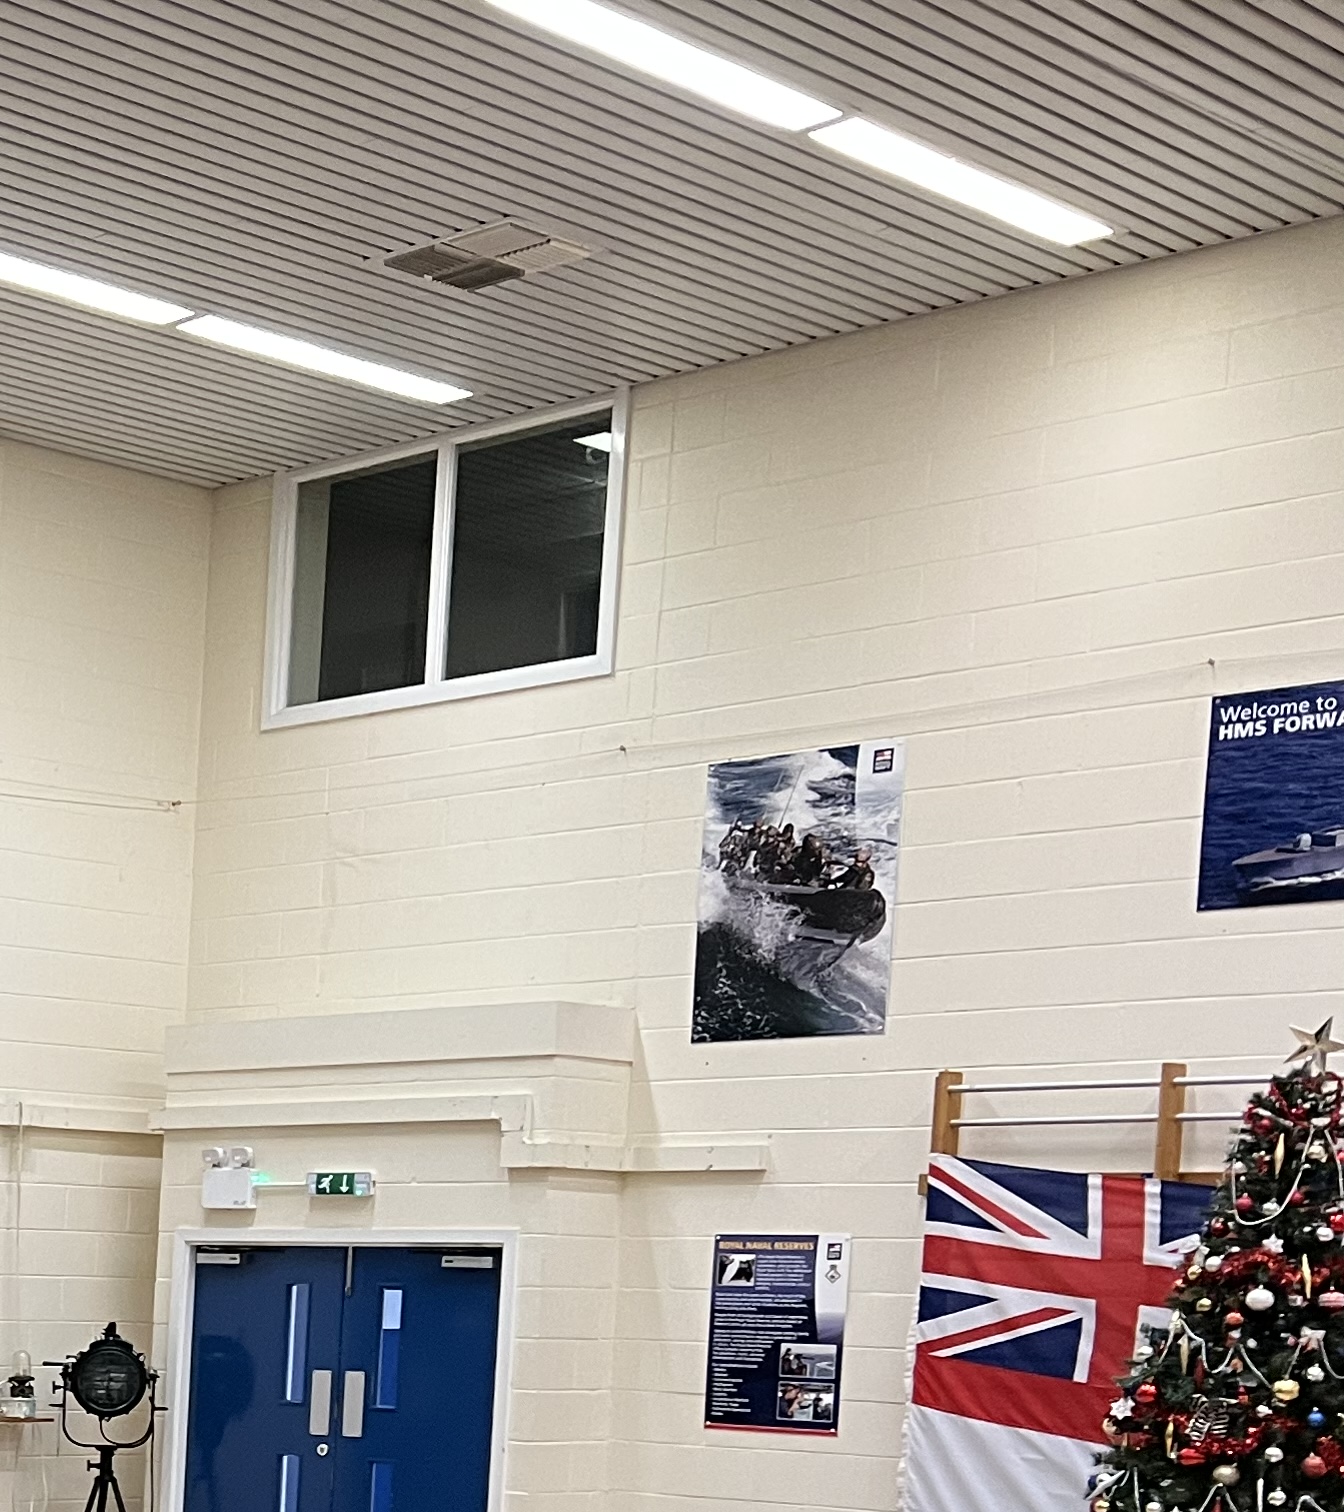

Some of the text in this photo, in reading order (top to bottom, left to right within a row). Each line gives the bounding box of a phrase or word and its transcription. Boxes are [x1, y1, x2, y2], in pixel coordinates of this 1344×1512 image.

[1219, 696, 1338, 723] Welcome to
[1218, 719, 1268, 741] HMS
